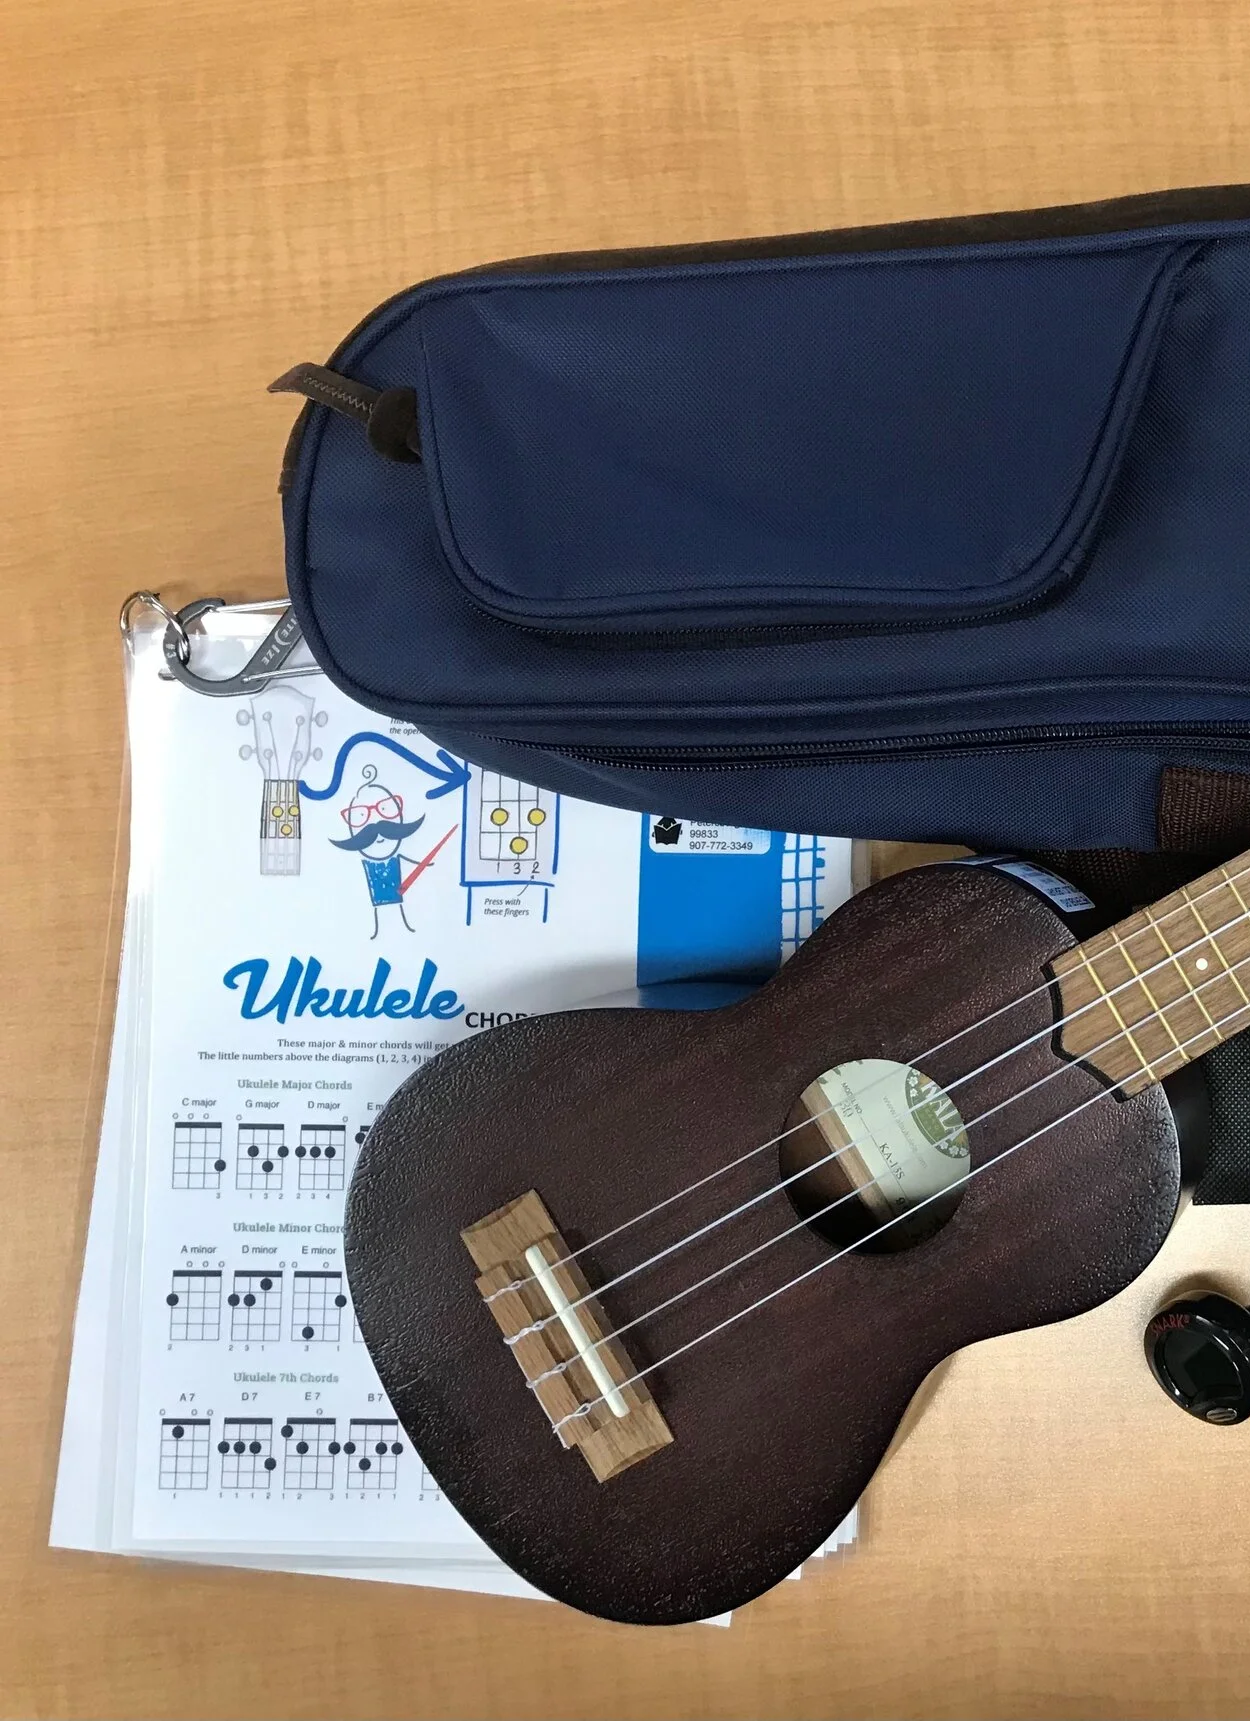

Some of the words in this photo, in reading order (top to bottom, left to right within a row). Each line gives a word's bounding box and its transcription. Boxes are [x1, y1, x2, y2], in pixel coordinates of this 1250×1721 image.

[689, 829, 719, 839] 99833
[689, 841, 754, 851] 907-772-3349
[513, 862, 522, 875] 3
[531, 861, 541, 874] 2
[484, 898, 504, 906] Press
[504, 898, 521, 906] with
[483, 907, 504, 916] these
[503, 907, 530, 918] fingers
[222, 955, 466, 1025] Ukulele
[277, 1038, 306, 1048] These
[308, 1039, 336, 1050] major
[338, 1040, 346, 1049] &
[348, 1040, 378, 1049] minor
[380, 1040, 412, 1049] chords
[414, 1041, 433, 1050] will
[197, 1051, 216, 1061] The
[218, 1051, 240, 1061] little
[242, 1052, 284, 1062] numbers
[285, 1053, 313, 1062] above
[315, 1053, 331, 1062] the
[332, 1053, 374, 1064] diagrams
[237, 1079, 279, 1089] Ukulele
[281, 1080, 313, 1092] Major
[314, 1080, 353, 1091] Chords
[191, 1098, 217, 1109] major
[255, 1100, 280, 1110] major
[317, 1102, 341, 1112] major
[233, 1222, 276, 1233] Ukulele
[278, 1223, 312, 1233] Minor
[190, 1245, 218, 1254] minor
[251, 1245, 278, 1254] minor
[310, 1245, 337, 1255] minor
[233, 1372, 277, 1383] Ukulele
[279, 1372, 297, 1383] 7th
[300, 1373, 340, 1384] Chords
